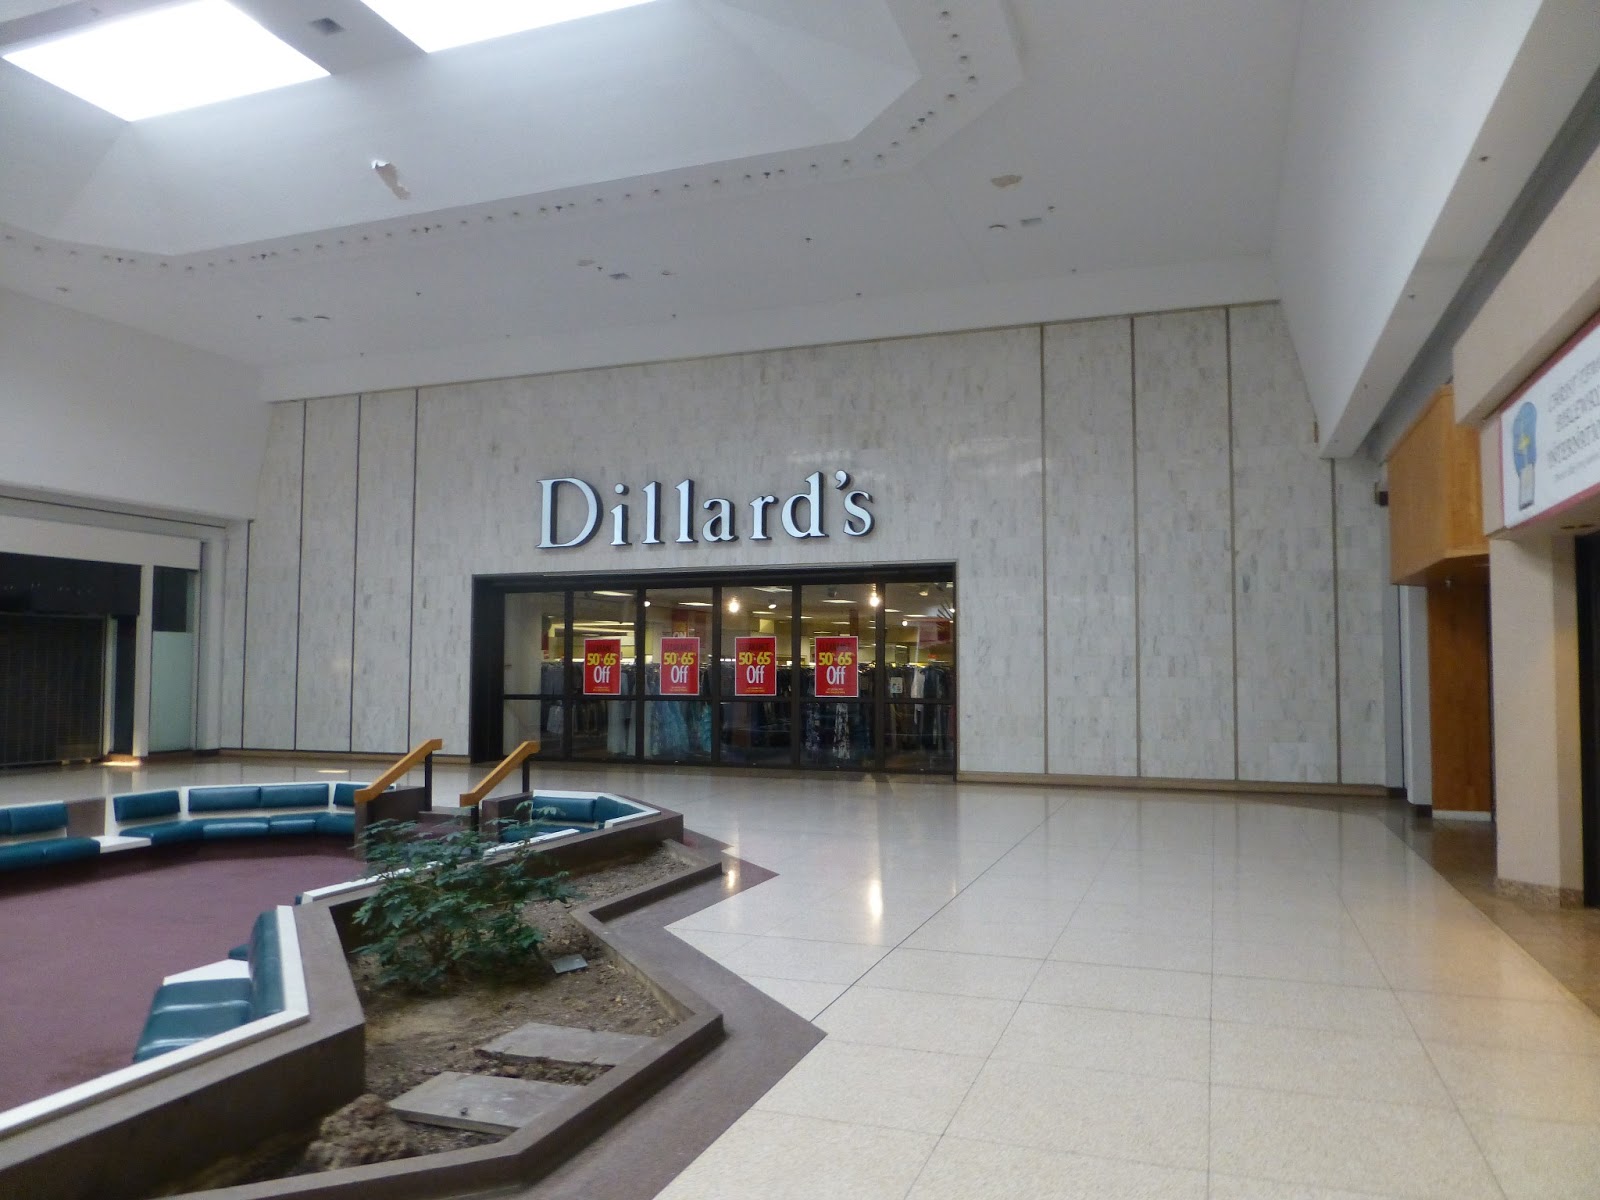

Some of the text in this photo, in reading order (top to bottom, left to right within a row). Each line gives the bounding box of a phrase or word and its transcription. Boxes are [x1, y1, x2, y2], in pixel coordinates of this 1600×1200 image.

[536, 470, 874, 549] Dillard's
[594, 665, 610, 683] Off
[671, 665, 688, 683] Off
[746, 665, 764, 684] Off
[826, 665, 846, 685] Off
